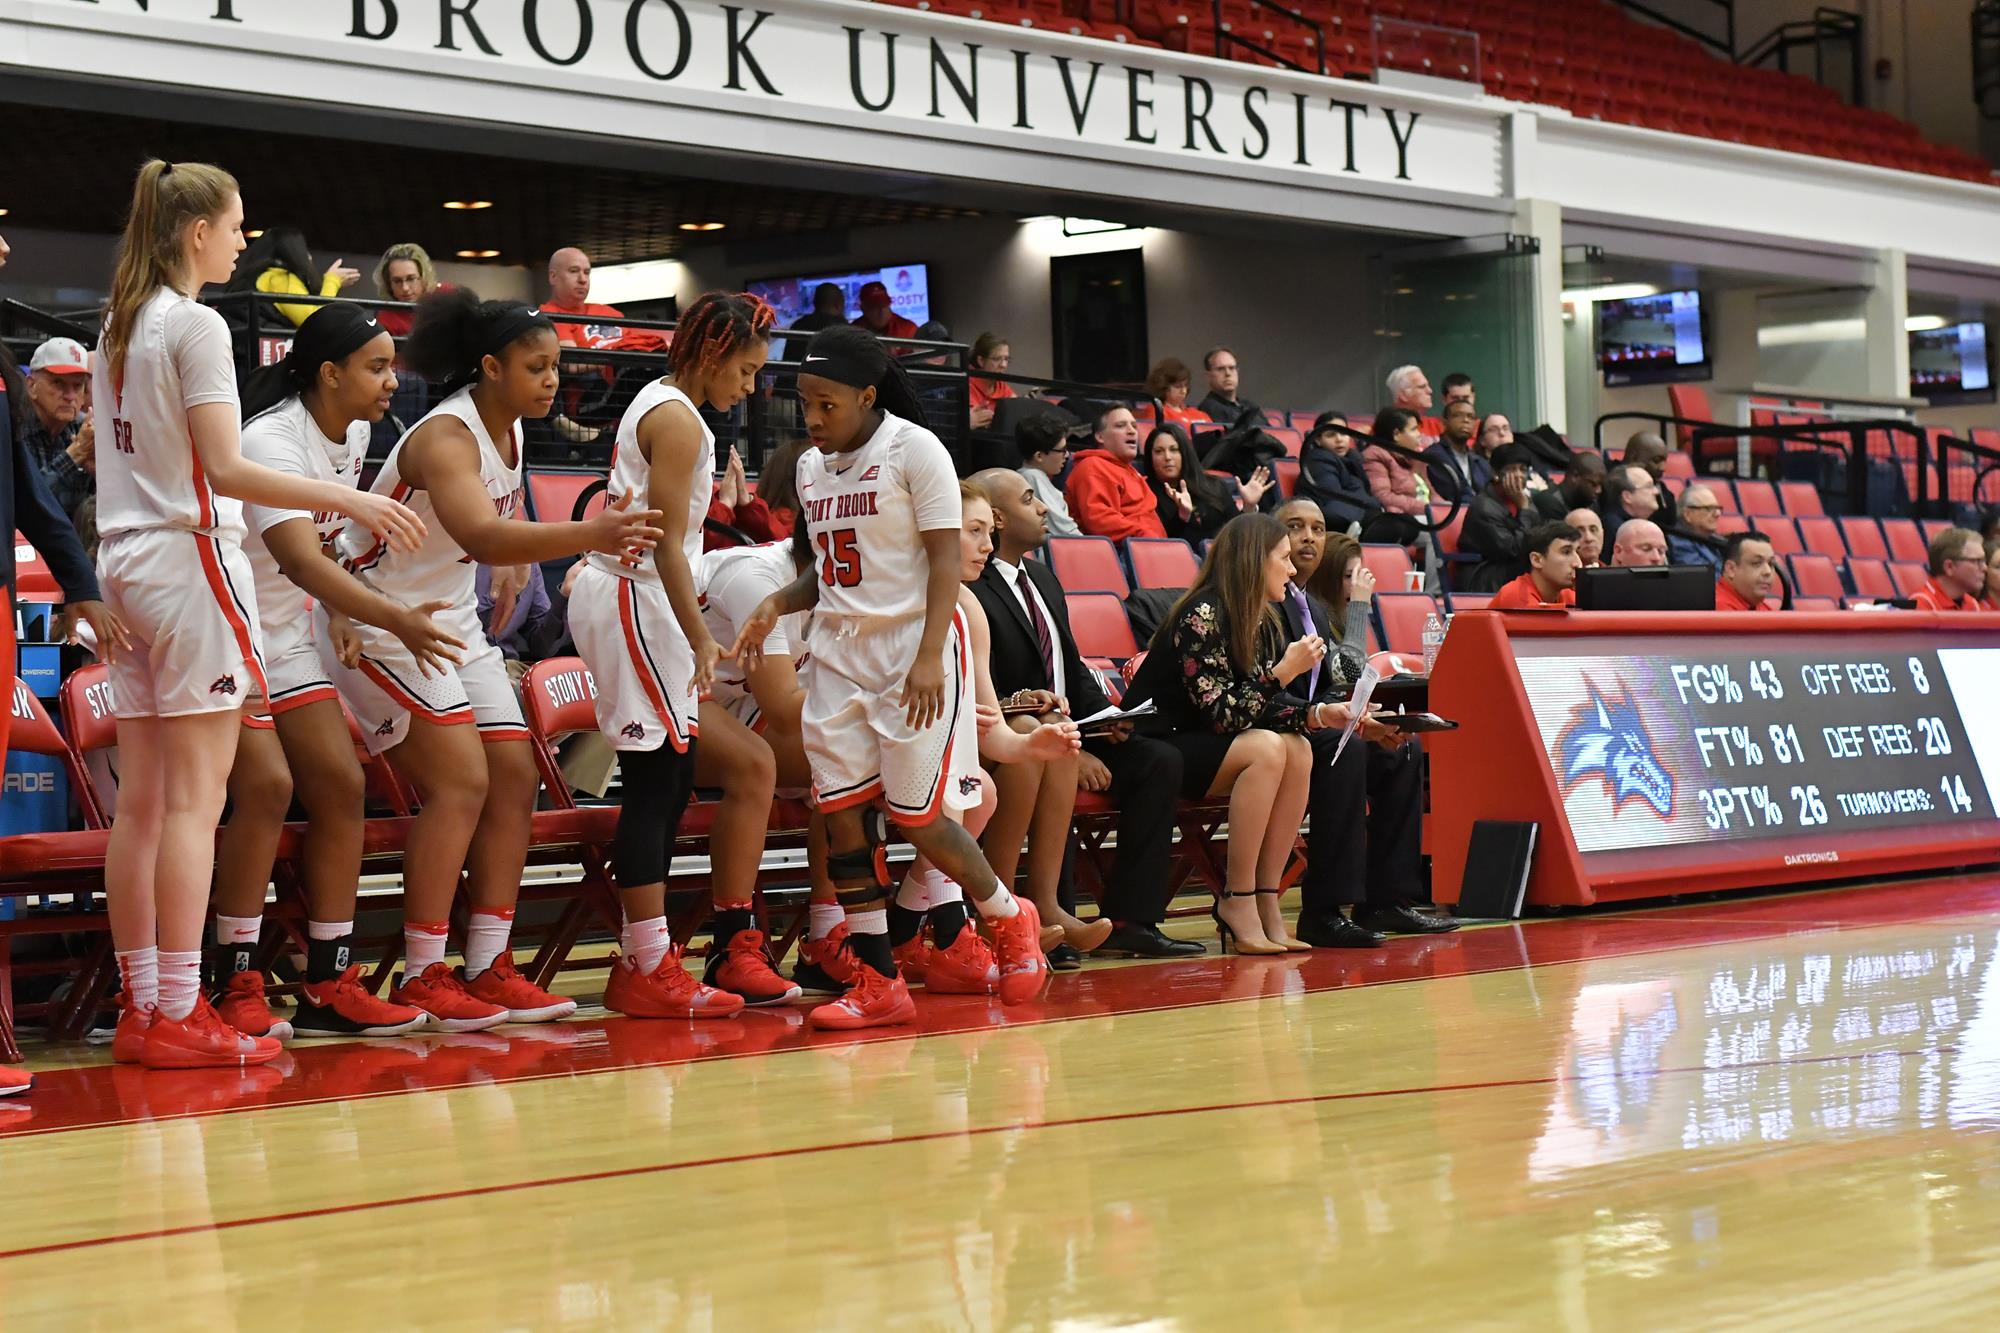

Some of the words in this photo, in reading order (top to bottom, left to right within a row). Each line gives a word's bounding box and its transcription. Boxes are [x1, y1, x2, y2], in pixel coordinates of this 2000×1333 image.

[842, 26, 1422, 181] UNIVERSITY
[890, 293, 925, 306] ROSTY
[805, 497, 834, 523] TONY
[835, 491, 878, 519] BROOK
[816, 528, 863, 587] 15
[21, 668, 55, 677] OWERADE
[544, 671, 586, 708] STONY
[1671, 664, 1743, 704] FG%
[1750, 660, 1784, 699] 43
[1801, 664, 1842, 695] OFF
[1846, 663, 1896, 694] REB:
[1908, 657, 1930, 694] 8
[1695, 726, 1763, 767] FT%
[1769, 724, 1805, 763] 81
[1823, 726, 1864, 758] DEF
[1868, 724, 1918, 756] REB:
[1917, 717, 1952, 756] 20
[1699, 785, 1783, 830] 3PT%
[1791, 785, 1828, 826] 26
[1837, 788, 1935, 818] TURNOVERS:
[1941, 775, 1973, 814] 14
[1784, 851, 1839, 866] DAKTRONICS
